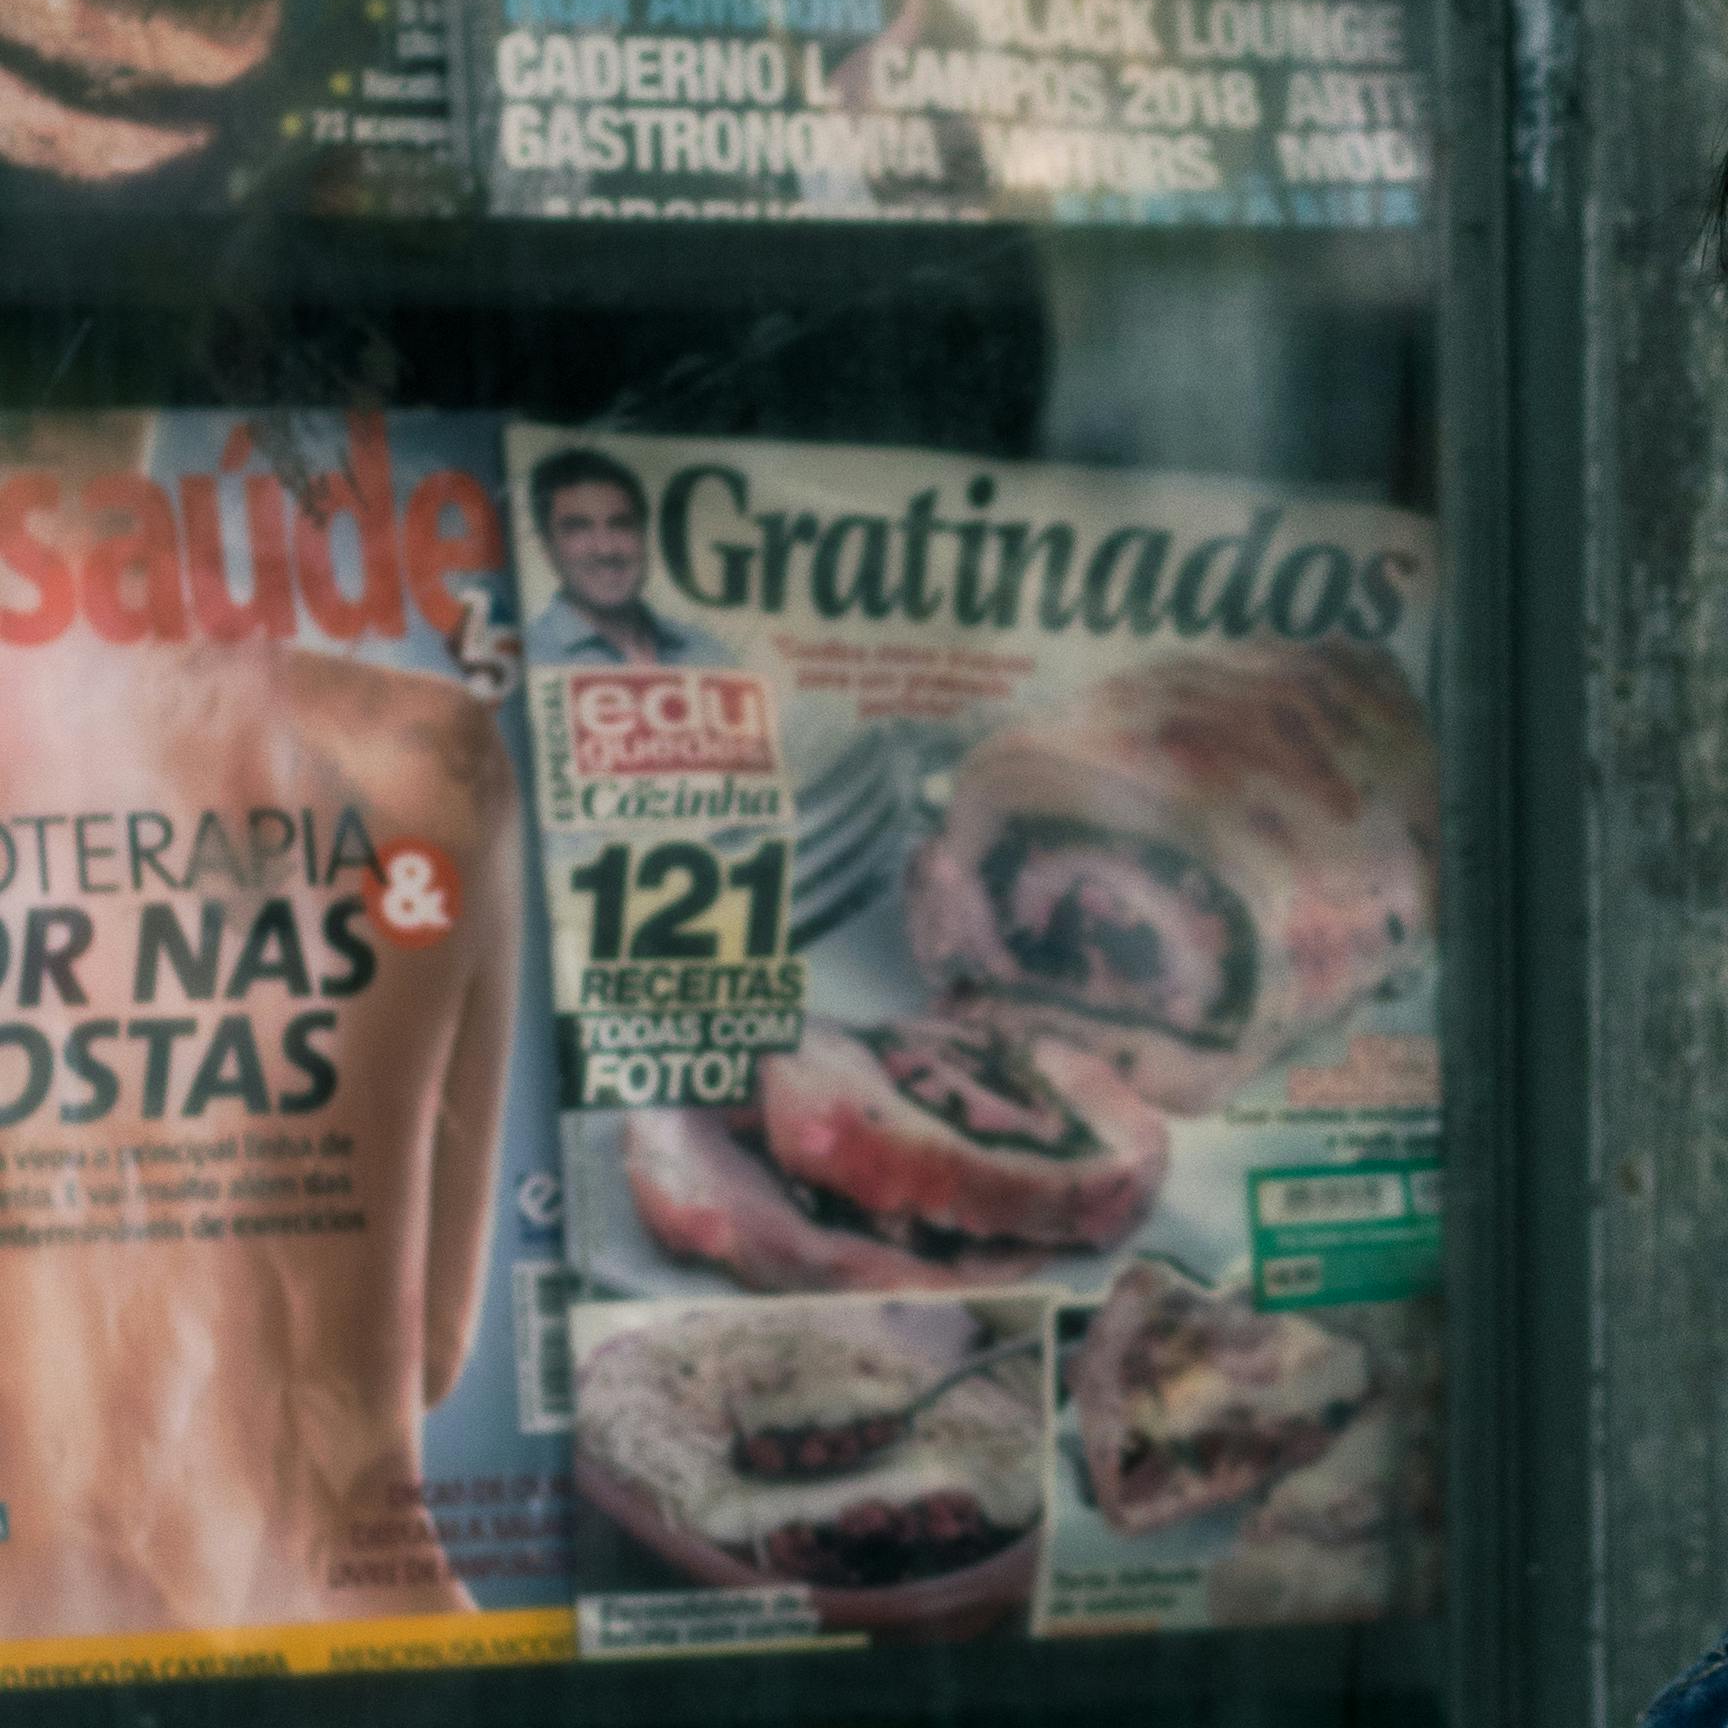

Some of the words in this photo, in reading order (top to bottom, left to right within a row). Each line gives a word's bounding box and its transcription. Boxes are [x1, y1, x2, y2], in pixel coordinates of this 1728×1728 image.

[497, 31, 788, 106] CADERNO
[872, 42, 1106, 122] CAMPOS
[1118, 64, 1262, 130] 2018
[502, 104, 944, 181] GASTRONOMIA
[0, 410, 498, 649] saúde
[658, 462, 1418, 643] Gratinados
[579, 673, 763, 735] edu
[0, 803, 388, 894] TERAPIA
[570, 840, 789, 963] 121
[0, 904, 96, 1008] R
[131, 895, 378, 1006] NAS
[580, 966, 804, 1009] RECEITAS
[582, 1013, 700, 1050] TODAS
[709, 1011, 798, 1046] COM
[581, 1050, 750, 1105] FOTO!
